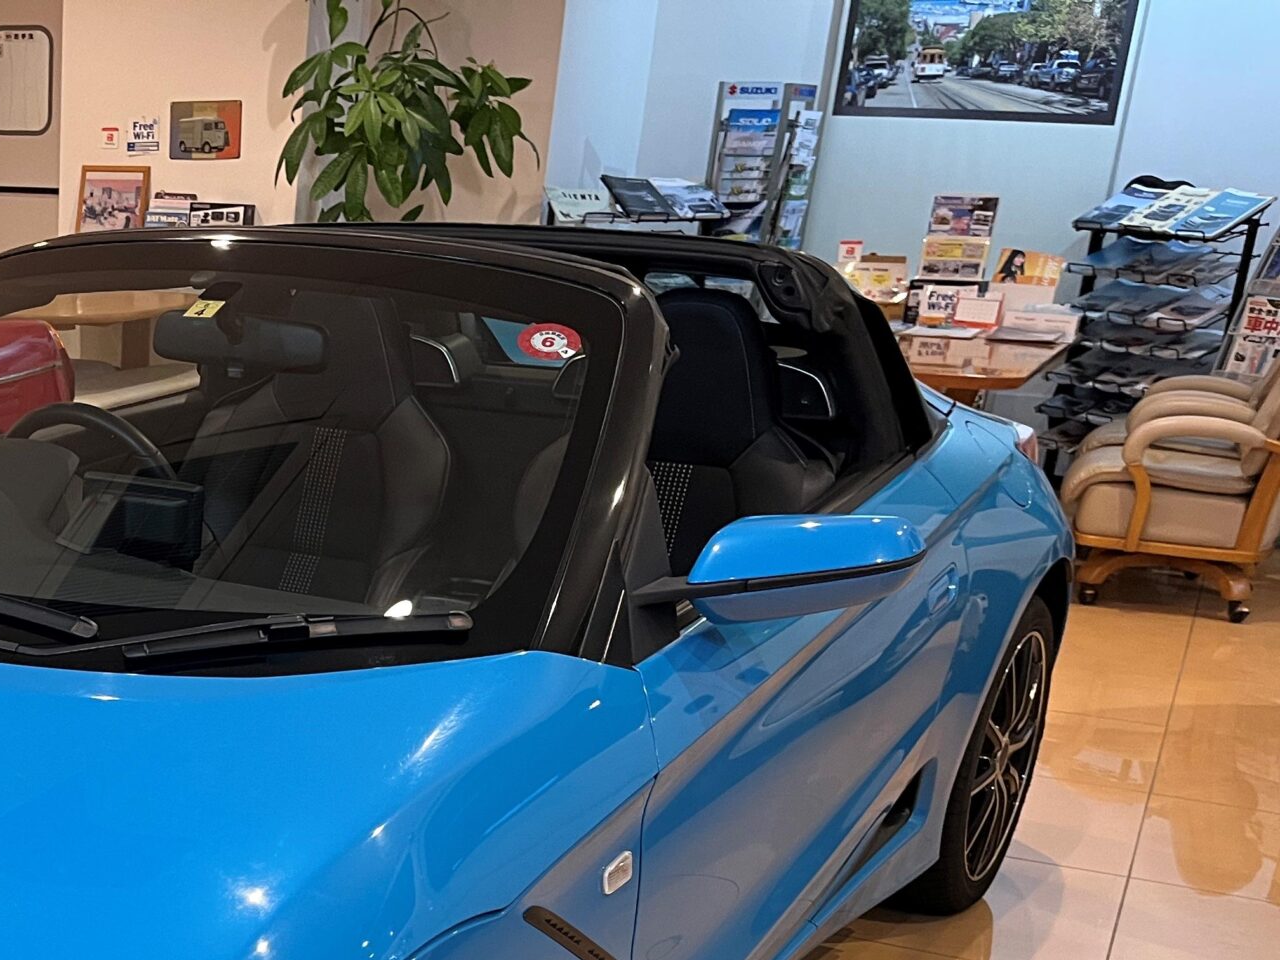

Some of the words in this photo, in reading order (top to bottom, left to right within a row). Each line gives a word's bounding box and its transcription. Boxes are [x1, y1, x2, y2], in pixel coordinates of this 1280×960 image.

[739, 86, 778, 95] SUZUKI
[133, 121, 155, 131] Free
[133, 131, 155, 140] Wi-Fi
[1244, 315, 1280, 336] 車中
[541, 336, 556, 348] 6
